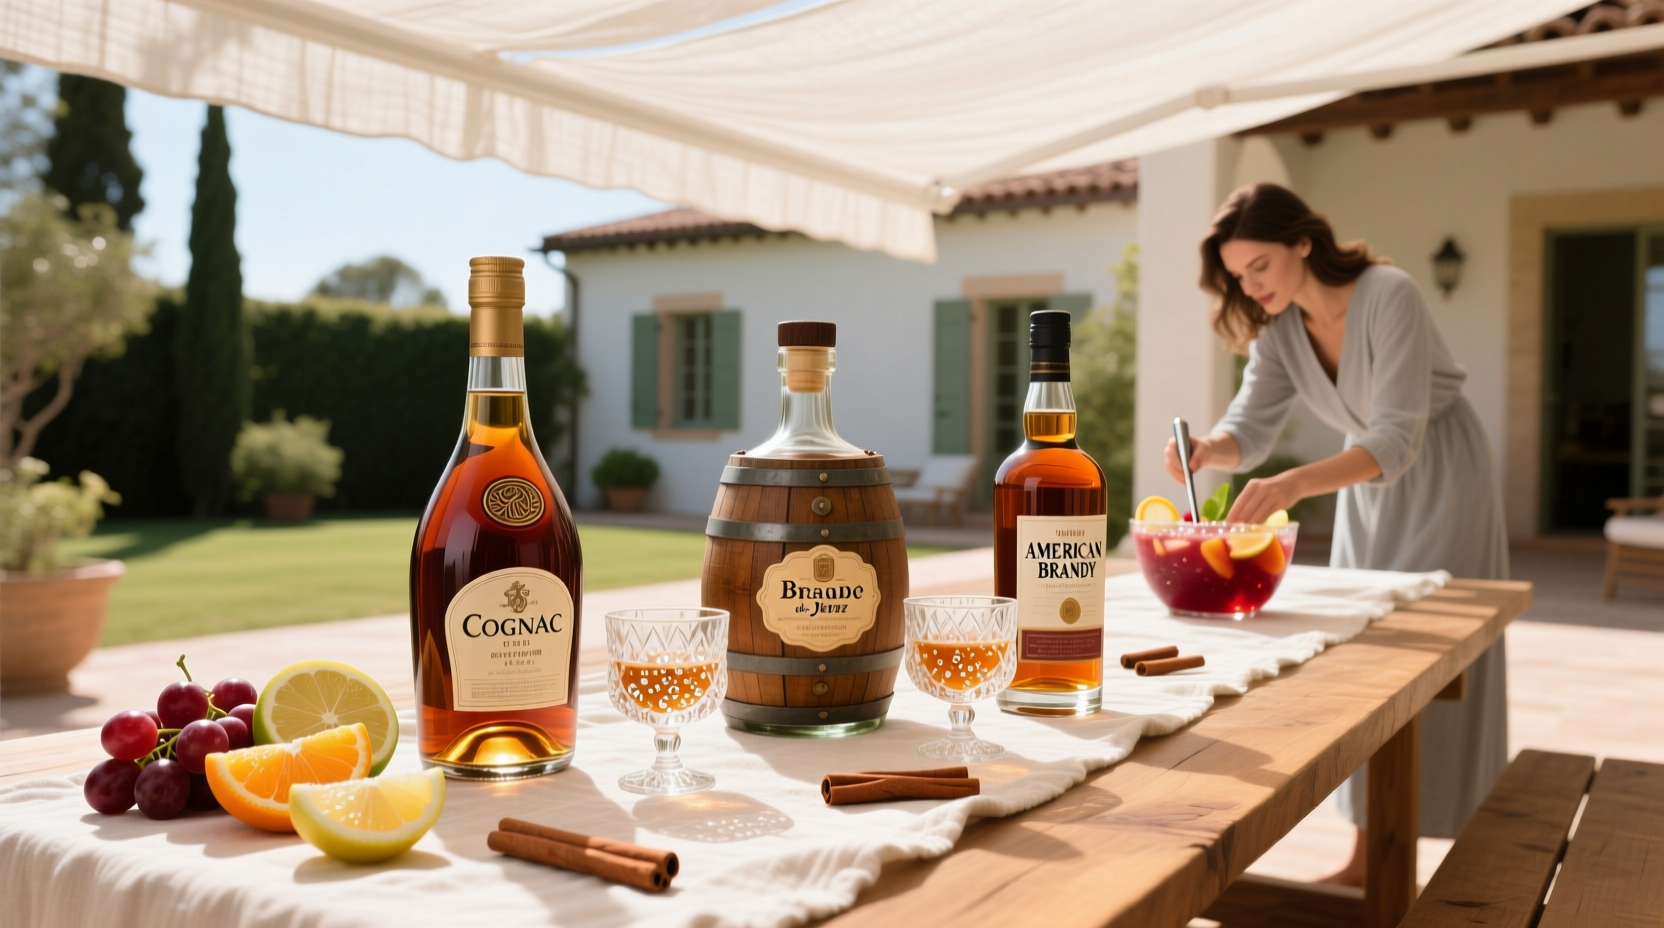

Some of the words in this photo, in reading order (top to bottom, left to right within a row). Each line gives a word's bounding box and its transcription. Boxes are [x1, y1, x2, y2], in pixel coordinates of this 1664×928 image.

[1025, 541, 1102, 559] AMERICAN
[1038, 561, 1097, 579] BRANDY
[462, 613, 562, 638] COGNAC
